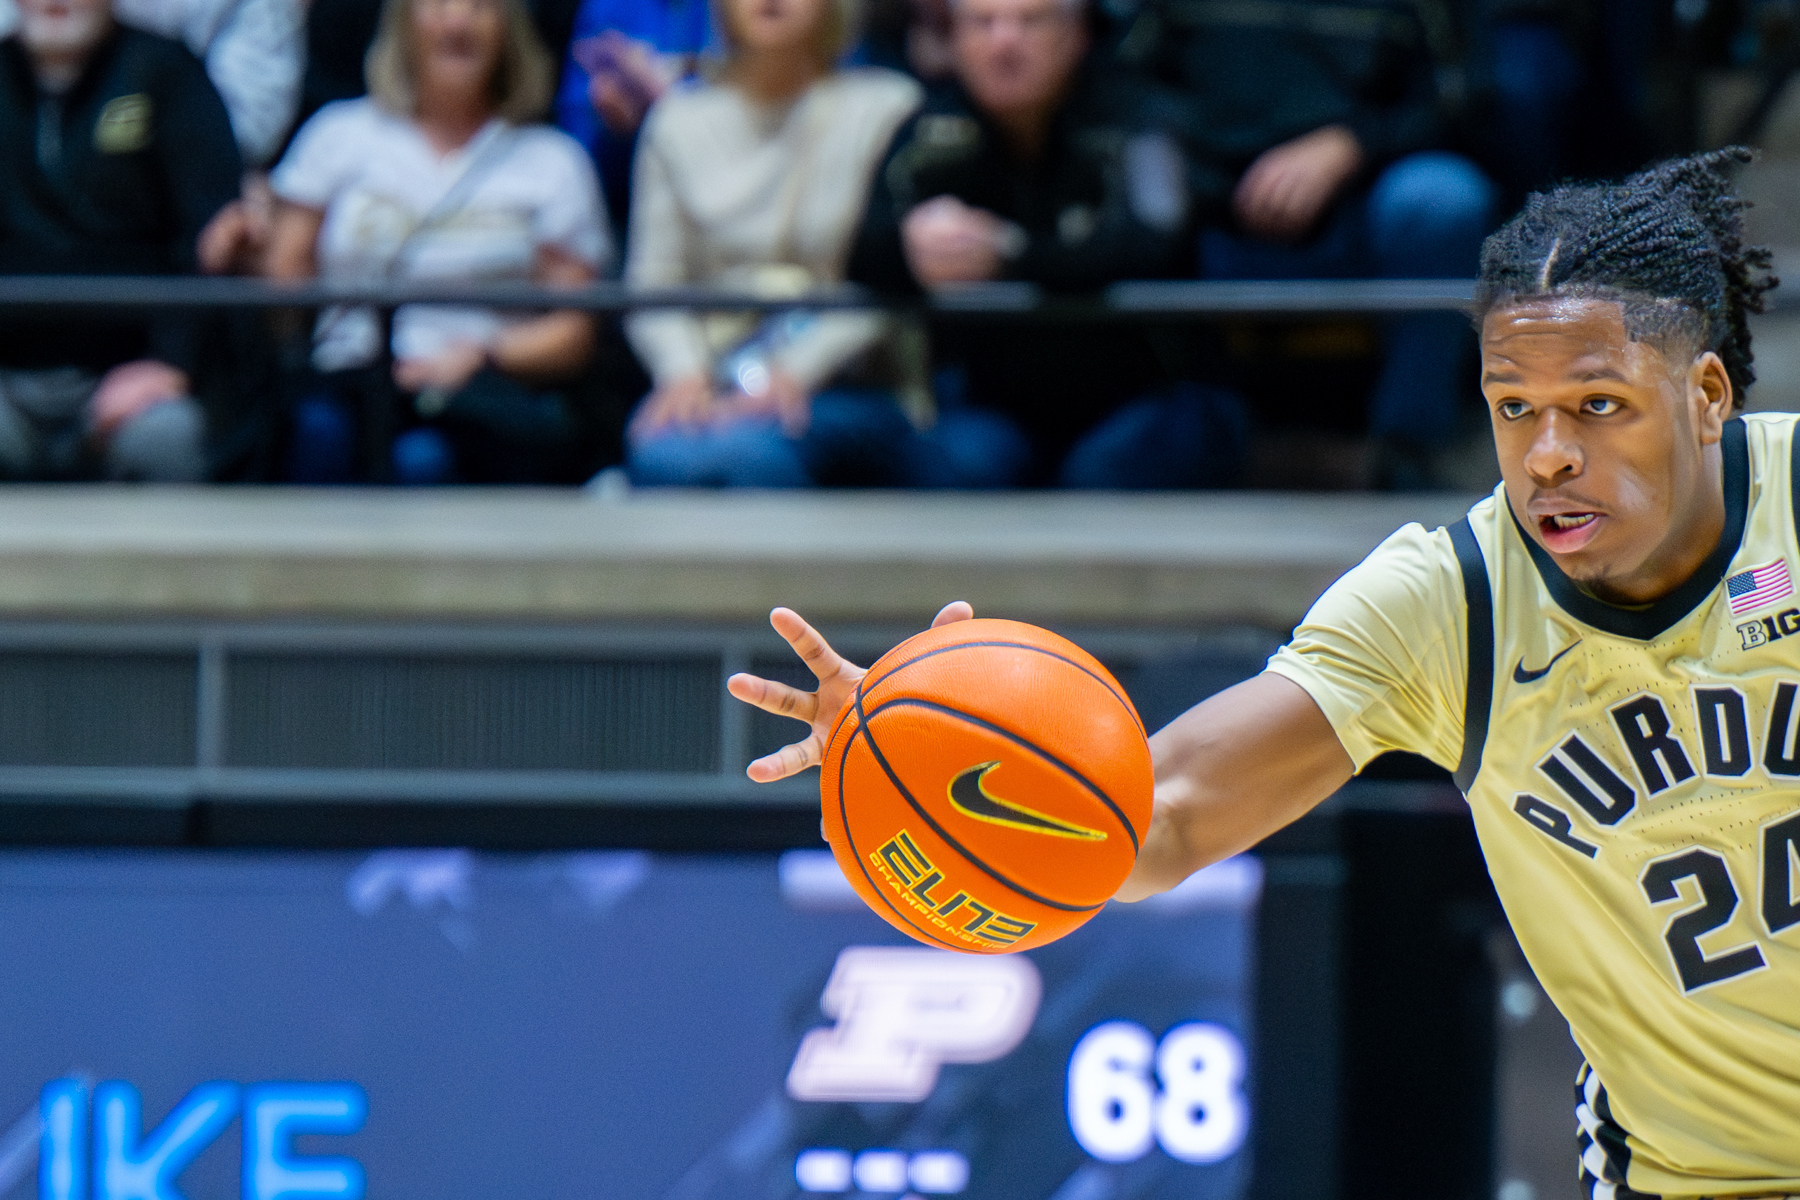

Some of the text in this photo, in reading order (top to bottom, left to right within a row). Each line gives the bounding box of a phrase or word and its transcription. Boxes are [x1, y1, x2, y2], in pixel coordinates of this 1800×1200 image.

[868, 851, 1009, 949] CHAMPIONSHIP
[876, 828, 1039, 945] ELITE
[1067, 1021, 1247, 1164] 68
